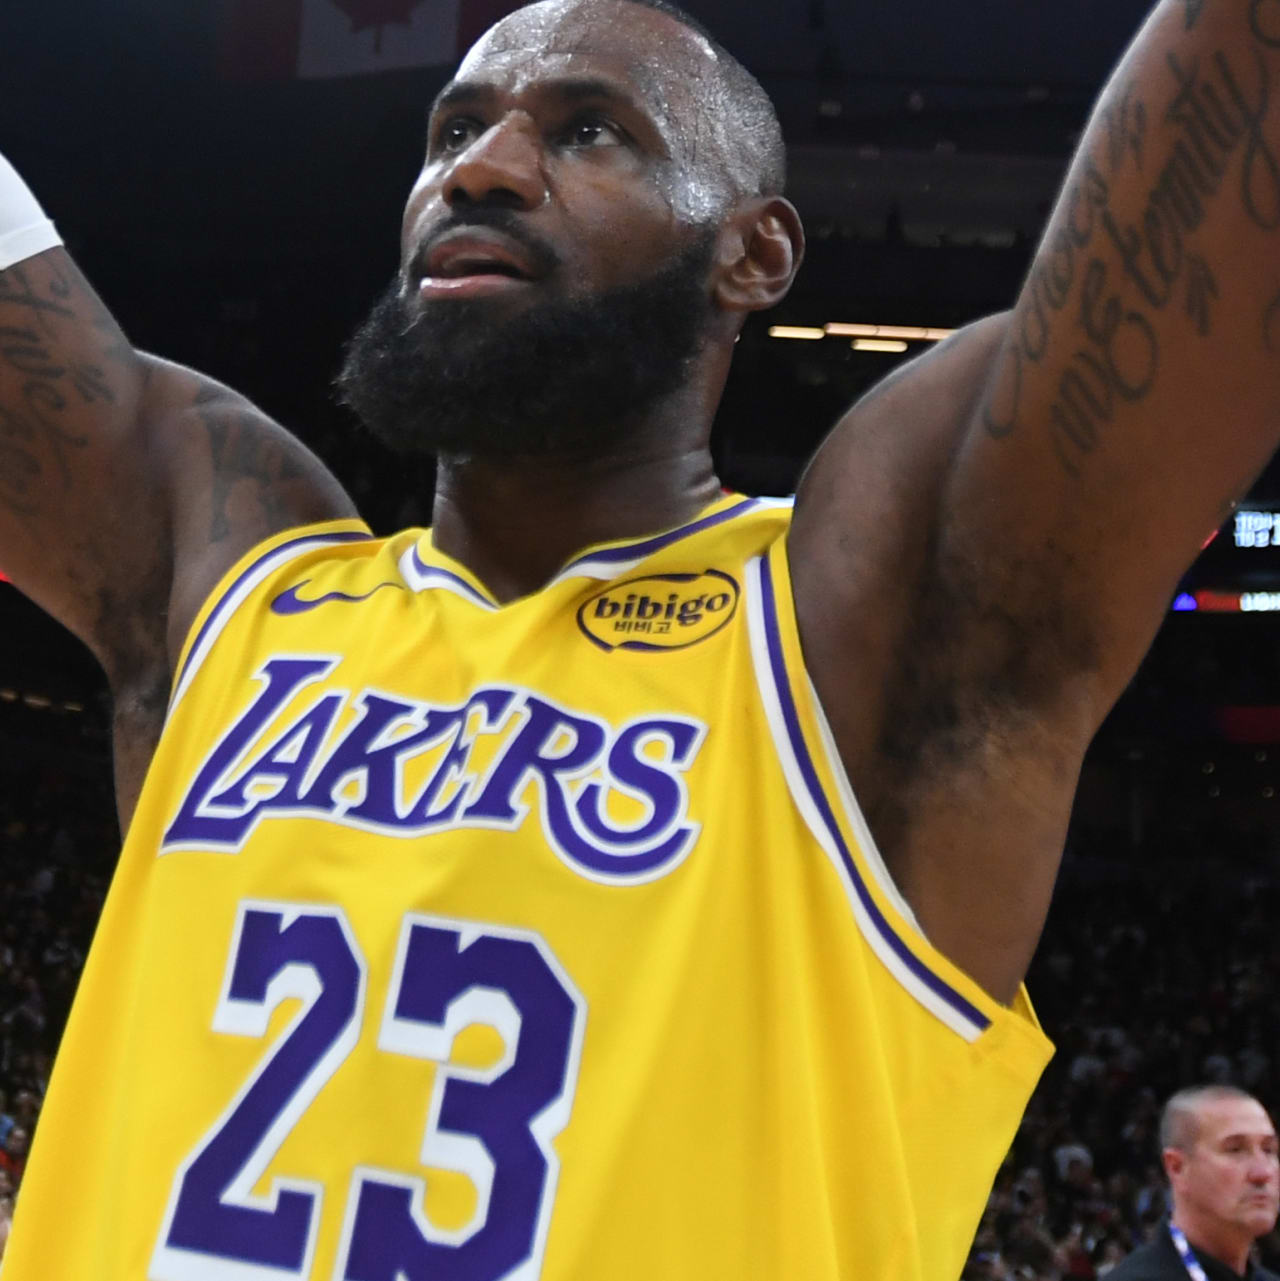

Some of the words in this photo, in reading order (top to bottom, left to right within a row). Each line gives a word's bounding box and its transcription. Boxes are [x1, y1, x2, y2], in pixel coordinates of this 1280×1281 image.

[594, 592, 732, 628] bibigo
[613, 621, 672, 635] 비비고
[159, 652, 709, 886] LAKERS
[146, 900, 587, 1281] 23
